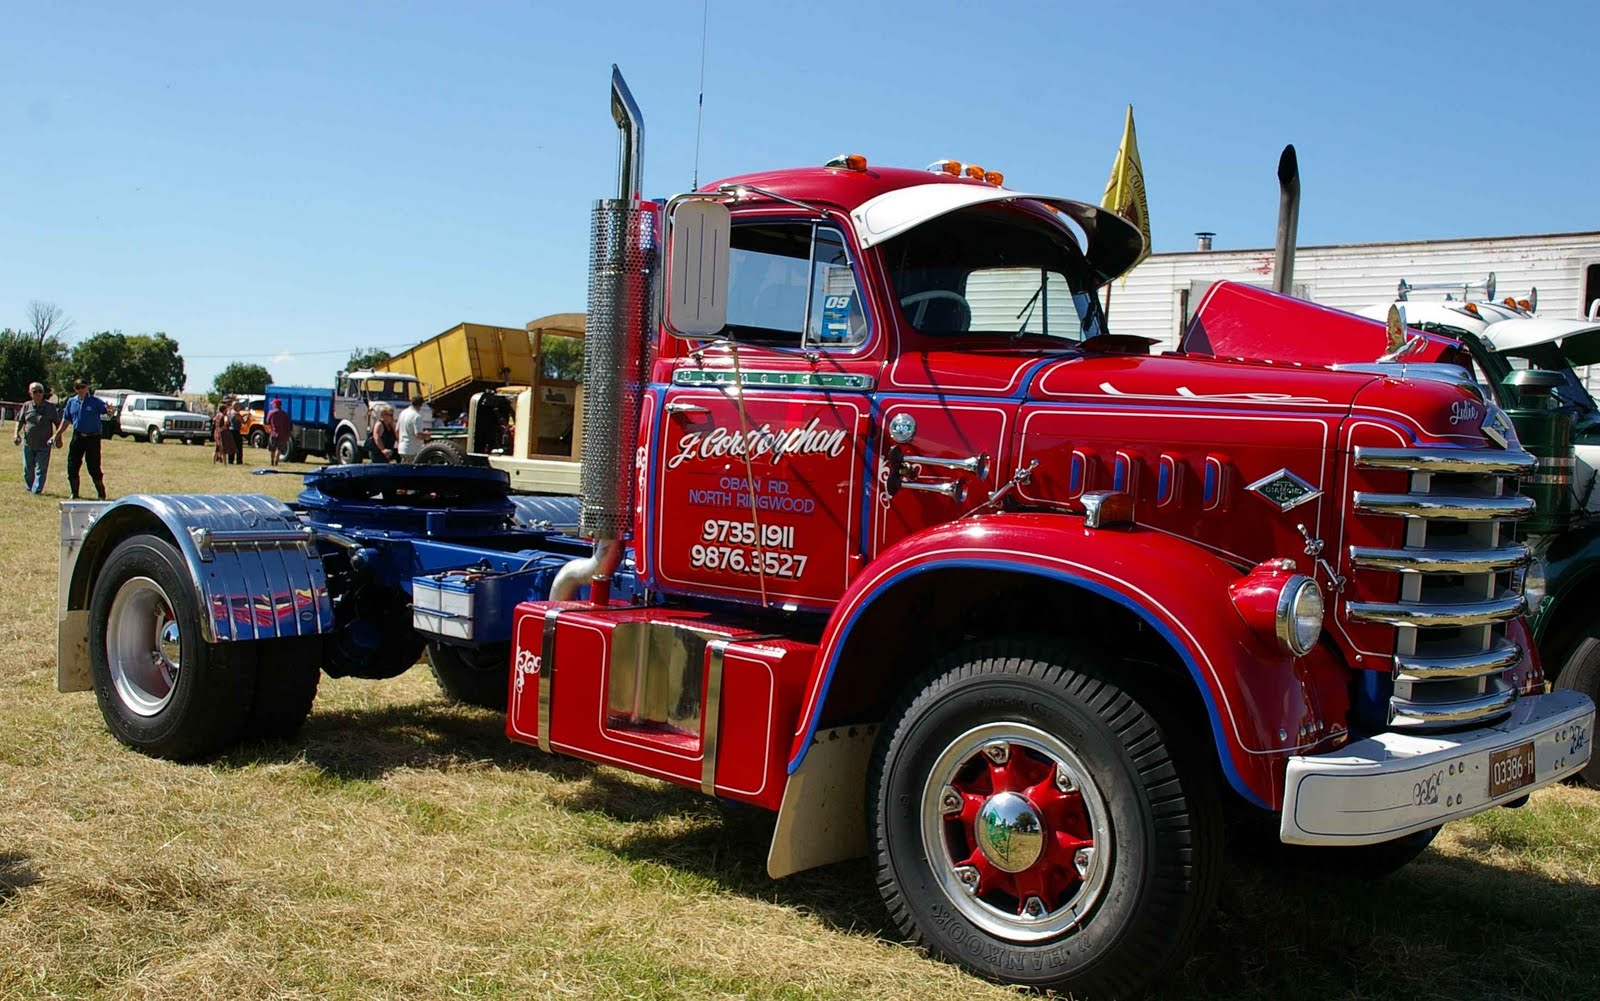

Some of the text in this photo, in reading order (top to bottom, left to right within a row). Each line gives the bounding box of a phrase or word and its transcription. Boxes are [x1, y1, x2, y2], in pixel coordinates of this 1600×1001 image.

[825, 296, 850, 309] 09
[1449, 401, 1479, 425] Julie
[719, 477, 790, 495] OBAN RD.
[689, 489, 815, 513] NORTH RINGWOOD
[691, 544, 808, 578] 9876.3527
[930, 903, 1068, 971] HANKOOK
